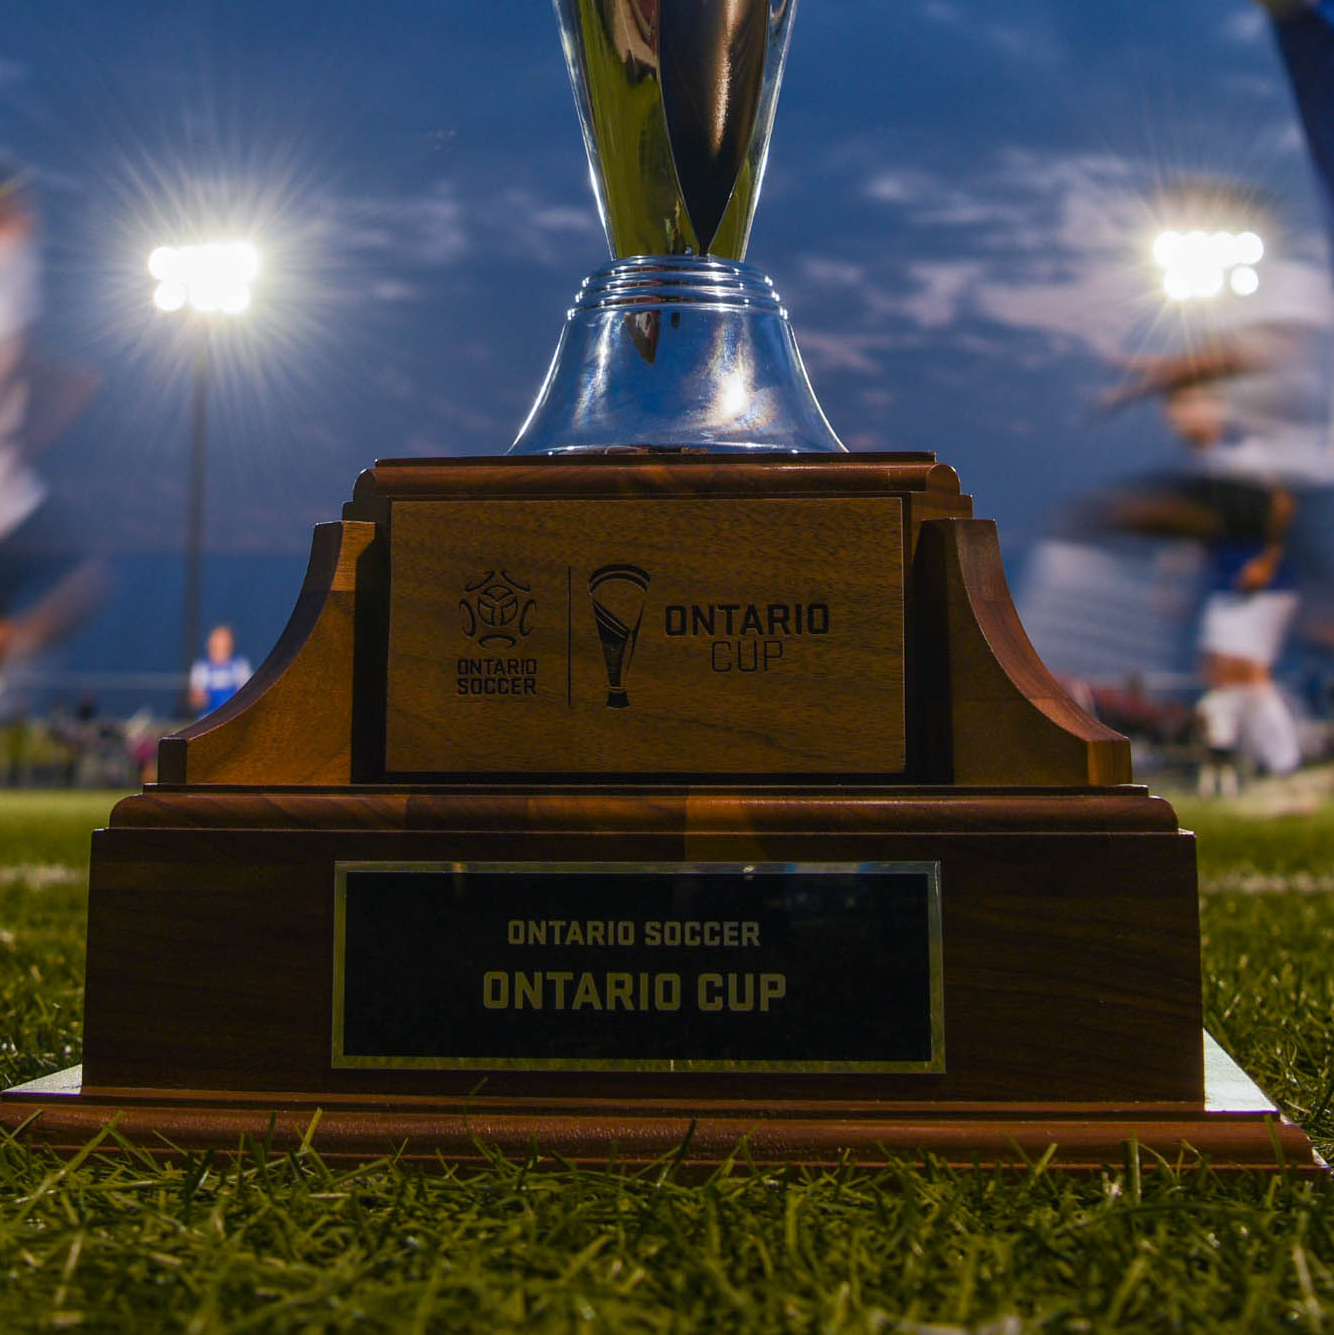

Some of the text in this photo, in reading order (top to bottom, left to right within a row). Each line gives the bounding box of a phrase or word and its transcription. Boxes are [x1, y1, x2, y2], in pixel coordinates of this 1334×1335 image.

[665, 603, 830, 636] ONTARIO
[457, 658, 538, 675] ONTARIO
[710, 639, 784, 673] CUP
[457, 678, 537, 695] SOCCER
[507, 920, 761, 946] ONTARIO SOCCER
[483, 971, 787, 1012] ONTARIO CUP
